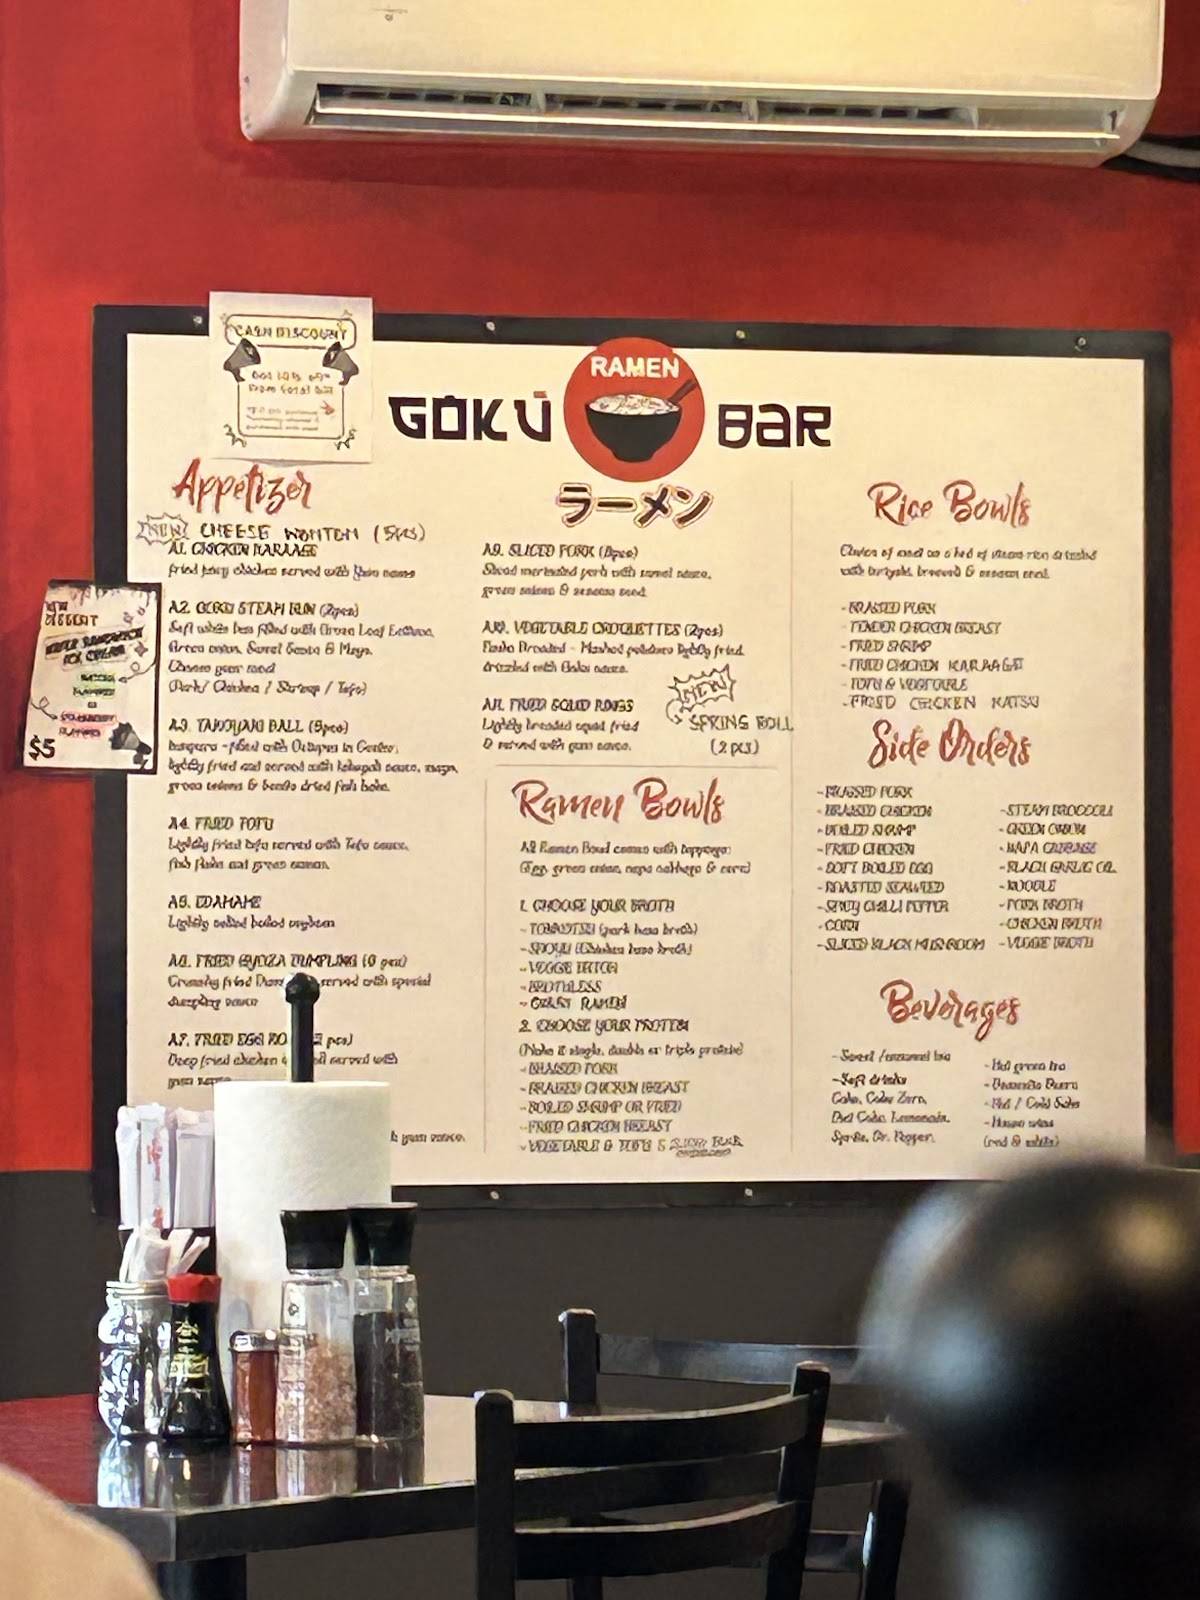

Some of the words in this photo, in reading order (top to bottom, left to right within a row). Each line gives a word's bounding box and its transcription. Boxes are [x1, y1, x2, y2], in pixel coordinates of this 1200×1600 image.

[590, 355, 680, 379] RAMEN
[173, 458, 311, 515] Appetizer
[556, 482, 714, 529] ラーメン
[867, 482, 933, 526] Rice
[943, 480, 1030, 528] Bowls
[200, 523, 271, 540] CHEESE
[29, 735, 56, 761] $5
[867, 719, 930, 769] Side
[939, 718, 1031, 767] Orders
[511, 780, 624, 825] Ramen
[633, 777, 725, 825] Bowls
[880, 979, 1021, 1042] Beverages
